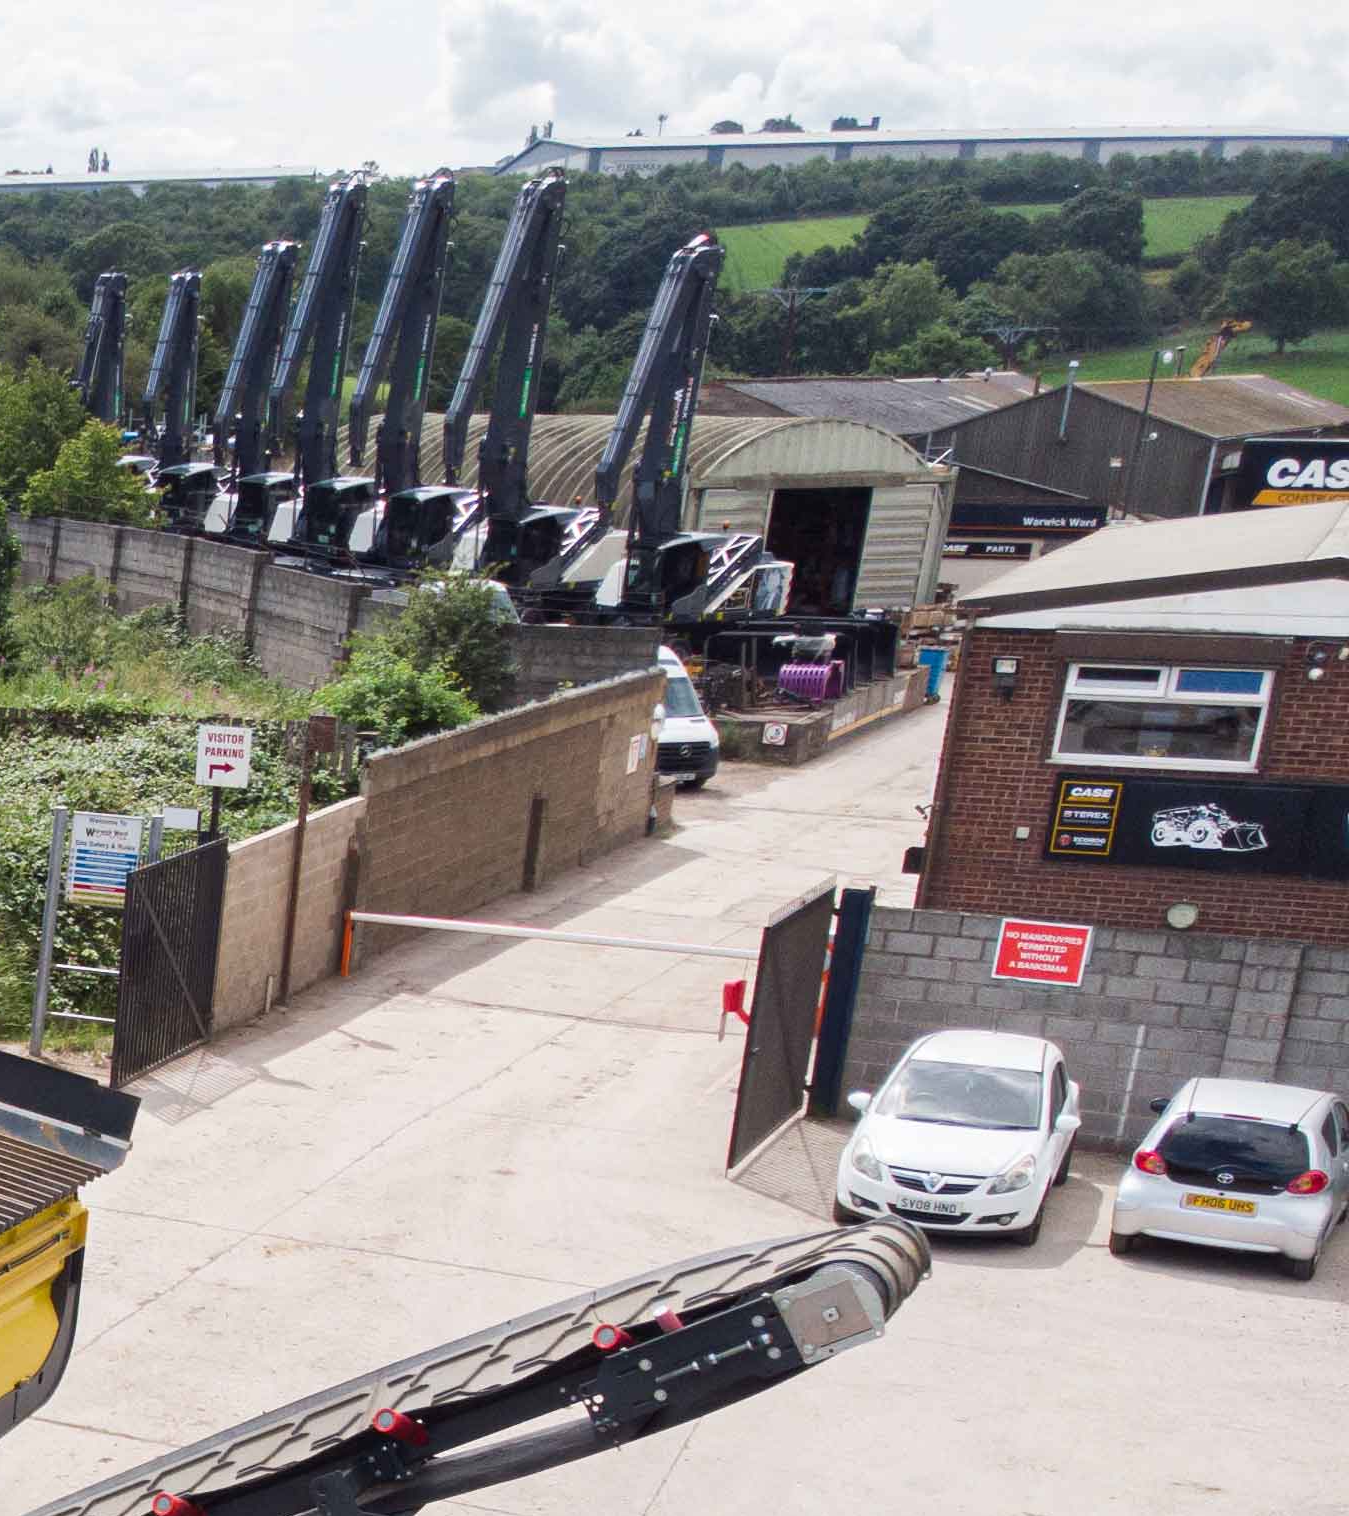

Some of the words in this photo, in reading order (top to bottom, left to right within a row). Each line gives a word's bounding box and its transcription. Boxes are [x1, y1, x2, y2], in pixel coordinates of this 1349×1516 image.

[1022, 516, 1066, 528] Warwick
[1069, 517, 1097, 528] Ward
[985, 545, 1015, 553] PARTS
[207, 733, 244, 744] VISITOR
[205, 747, 244, 759] PARKING
[1070, 787, 1114, 798] CASE
[1074, 811, 1110, 820] TEREX
[1005, 931, 1020, 939] NO
[1021, 932, 1083, 945] MANOEUVRES
[1017, 942, 1068, 953] PERMITTED
[1020, 951, 1062, 963] WITHOUT
[1017, 961, 1069, 973] BANKSMAN
